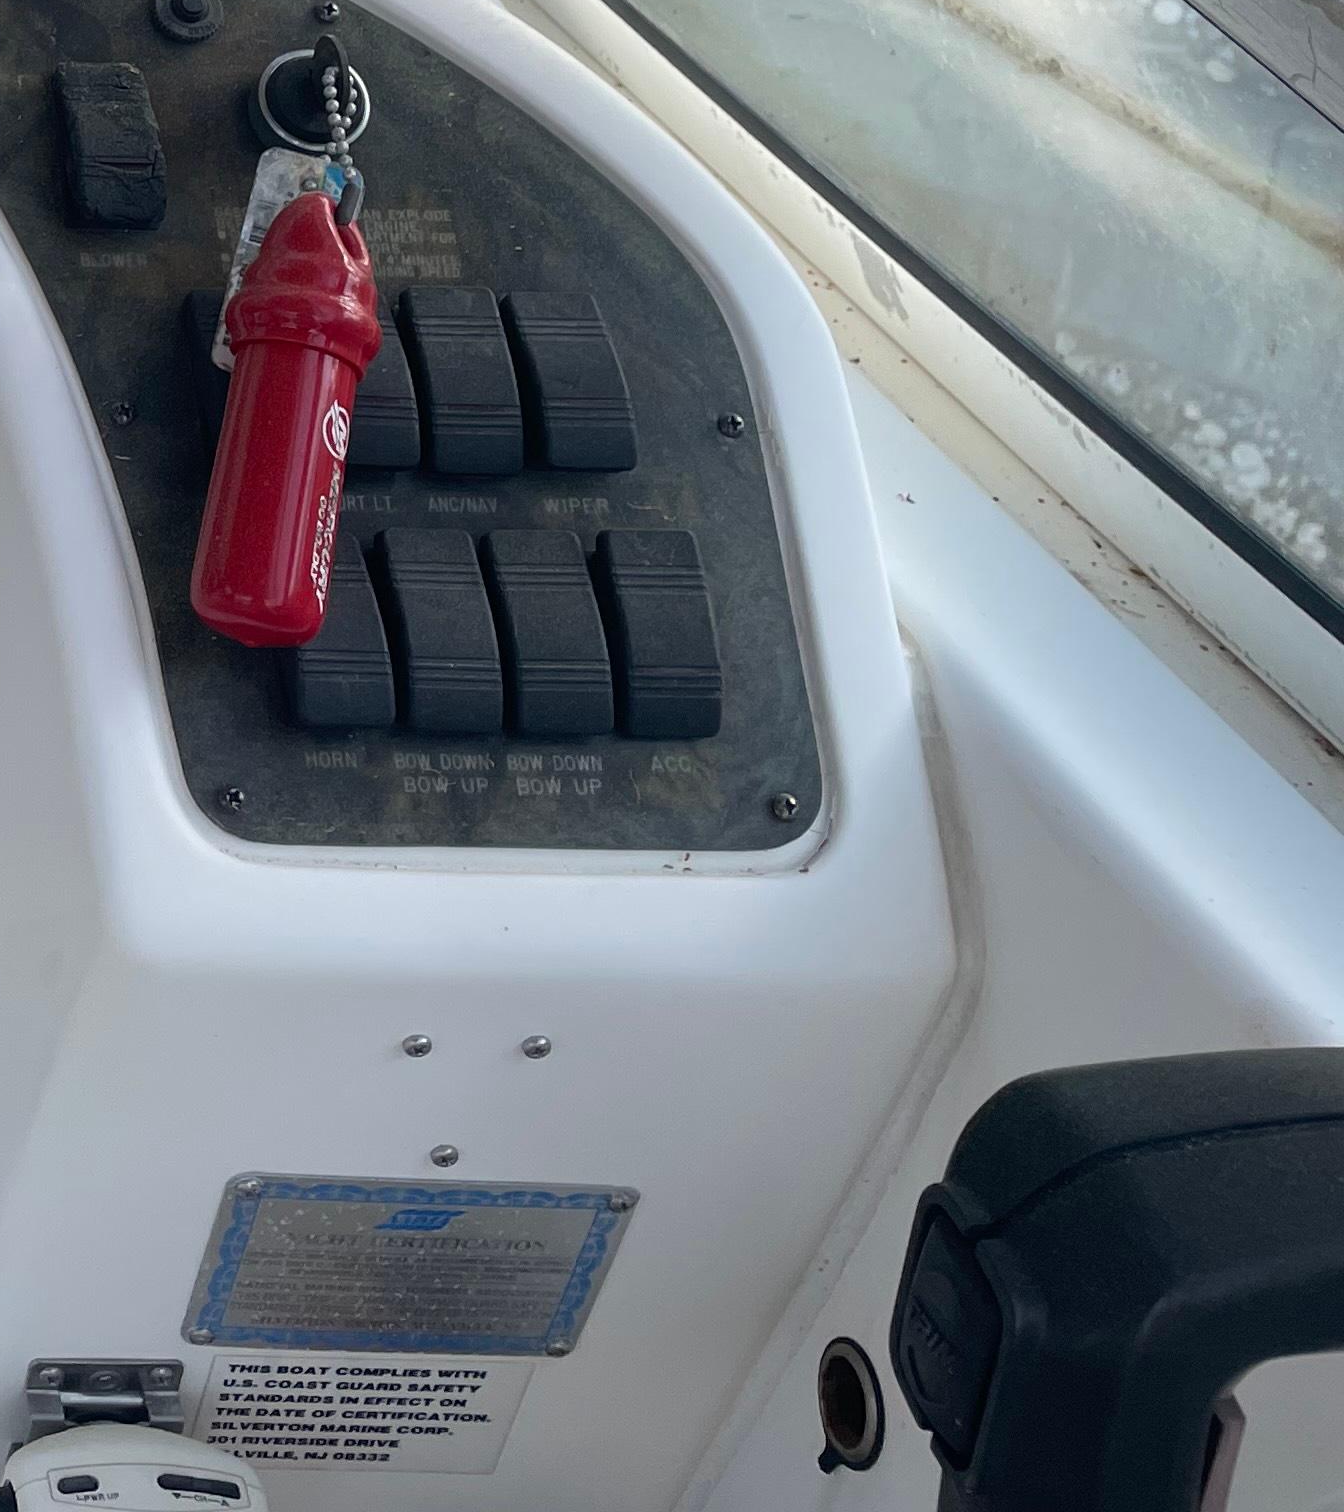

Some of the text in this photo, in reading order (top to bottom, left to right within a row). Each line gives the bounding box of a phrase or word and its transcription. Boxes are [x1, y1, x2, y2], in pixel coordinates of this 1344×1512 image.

[544, 498, 610, 514] WIPER
[305, 752, 358, 769] HORN
[394, 752, 491, 772] BOW DOWN
[506, 753, 603, 772] BOW DOWN
[403, 776, 490, 794] BOW UP
[516, 776, 603, 796] BOW UP
[228, 1364, 488, 1380] THIS BOAT COMPLIES WITH
[223, 1379, 483, 1394] U.S. COAST GUARD SAFETY
[219, 1393, 468, 1408] STANDARDS IN EFFECT ON
[215, 1407, 493, 1424] THE DATE OF CERTIFICATION.
[211, 1421, 454, 1436] SILVERTON MARINE CORP.
[241, 1437, 339, 1448] RIVERSIDE
[343, 1438, 401, 1449] DRIVE
[303, 1451, 329, 1461] NJ
[332, 1452, 391, 1462] 08332
